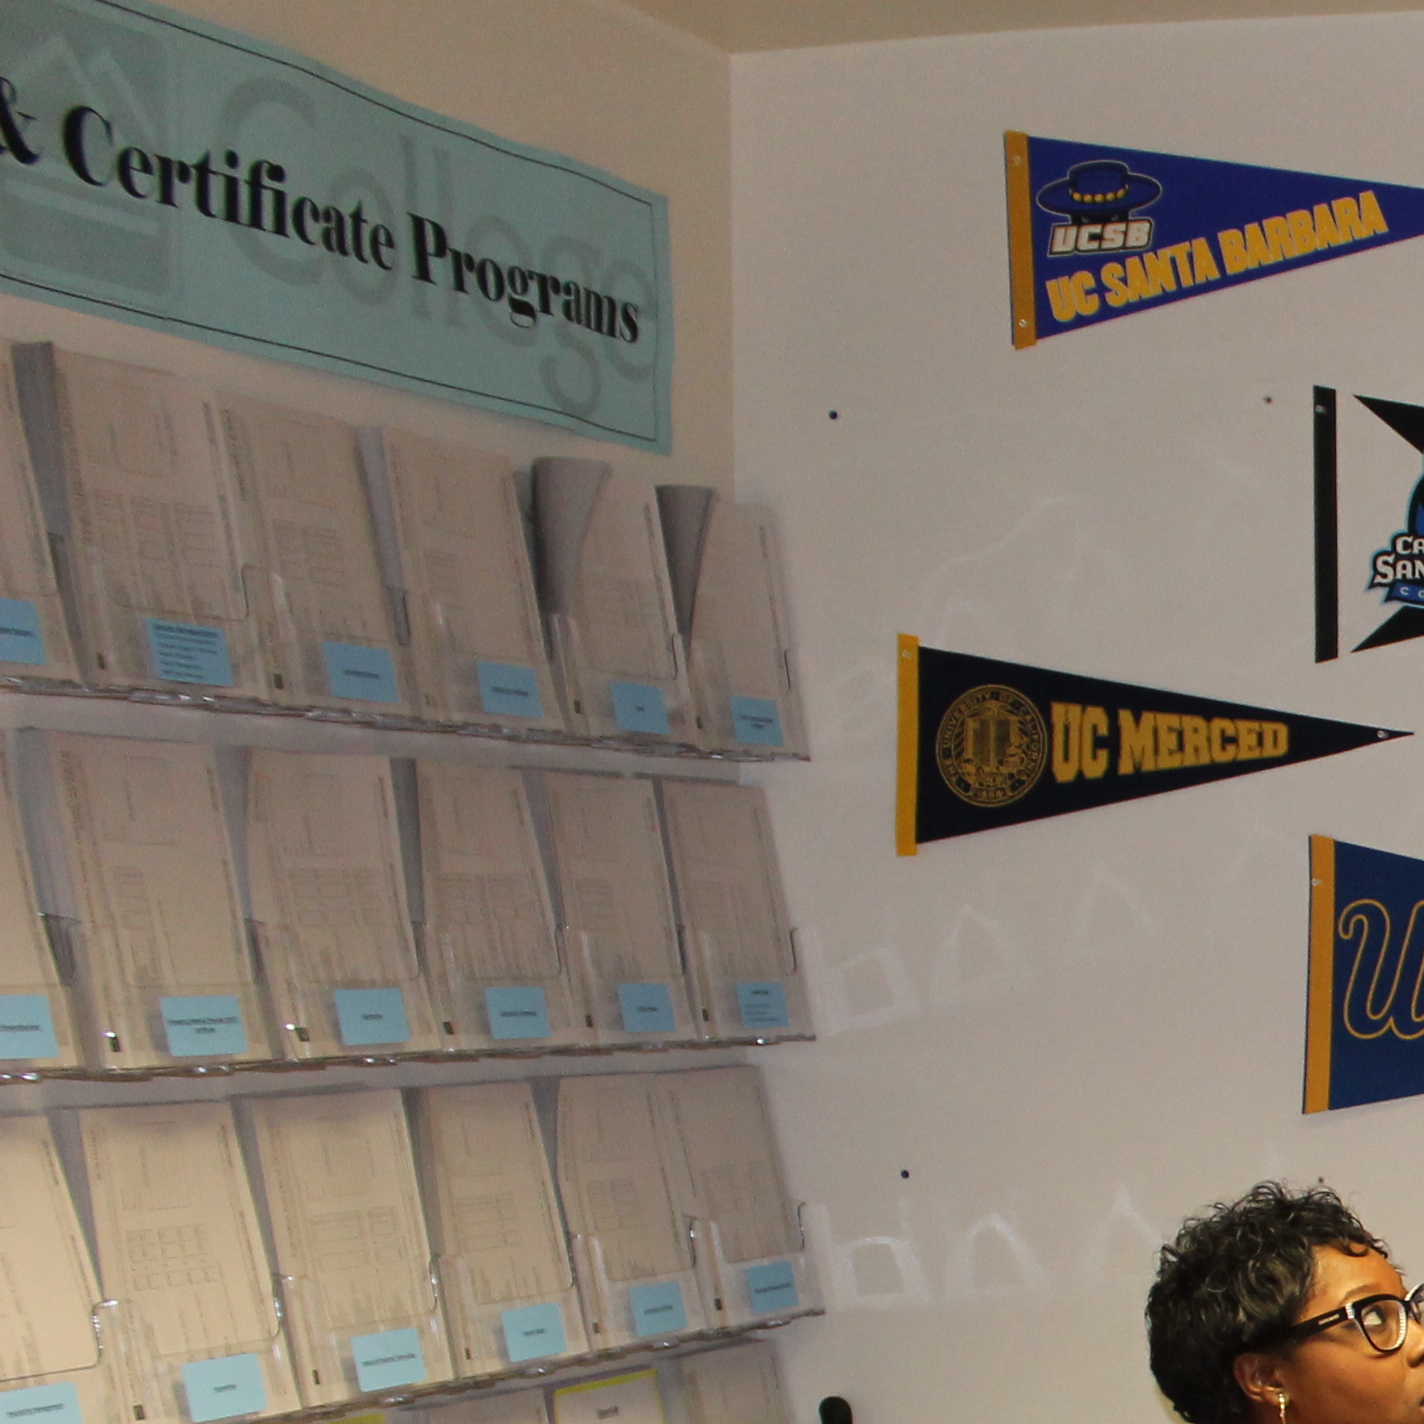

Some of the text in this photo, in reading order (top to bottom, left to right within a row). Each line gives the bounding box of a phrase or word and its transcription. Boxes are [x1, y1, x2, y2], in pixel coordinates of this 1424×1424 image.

[62, 104, 397, 271] Certificate
[406, 210, 641, 345] Programs
[1045, 188, 1390, 323] UC SANTA BARBARA
[1050, 220, 1152, 253] UCSB
[1050, 701, 1290, 784] UC MERCED
